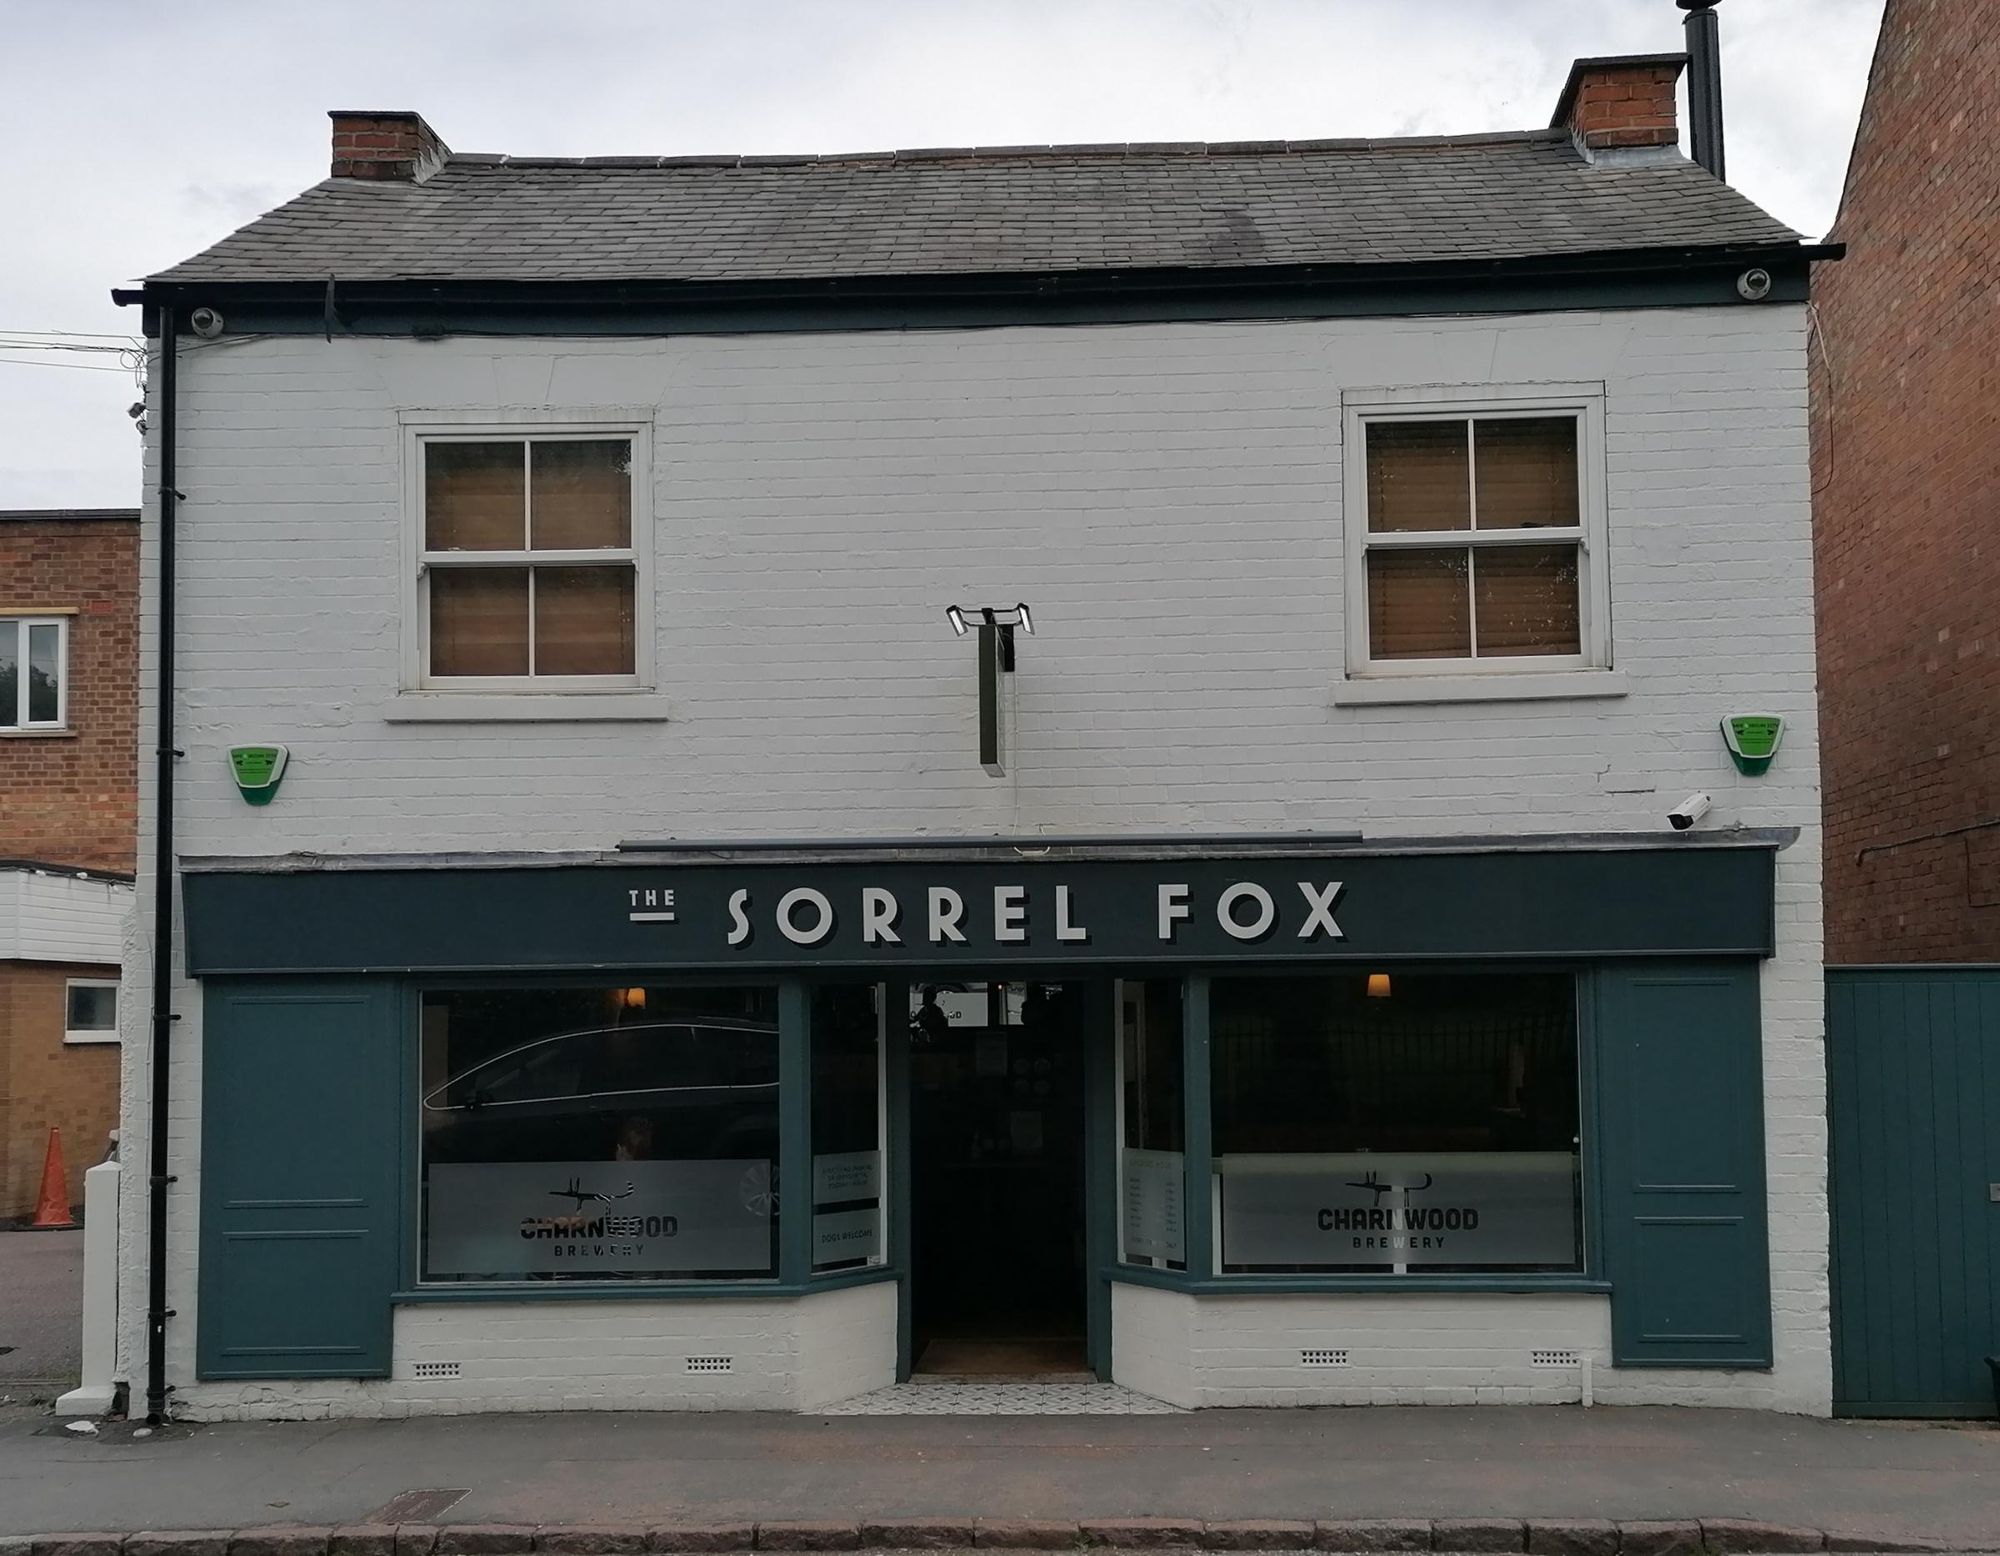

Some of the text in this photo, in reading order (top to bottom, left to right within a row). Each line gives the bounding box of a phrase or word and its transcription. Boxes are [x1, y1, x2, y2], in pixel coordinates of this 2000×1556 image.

[629, 881, 1344, 945] THE SORREL FOX
[520, 1216, 678, 1239] CHARNWOOD
[1318, 1208, 1477, 1230] CHARNWOOD
[821, 1229, 872, 1244] DOGS WELCOME
[1353, 1236, 1444, 1248] BREWERY
